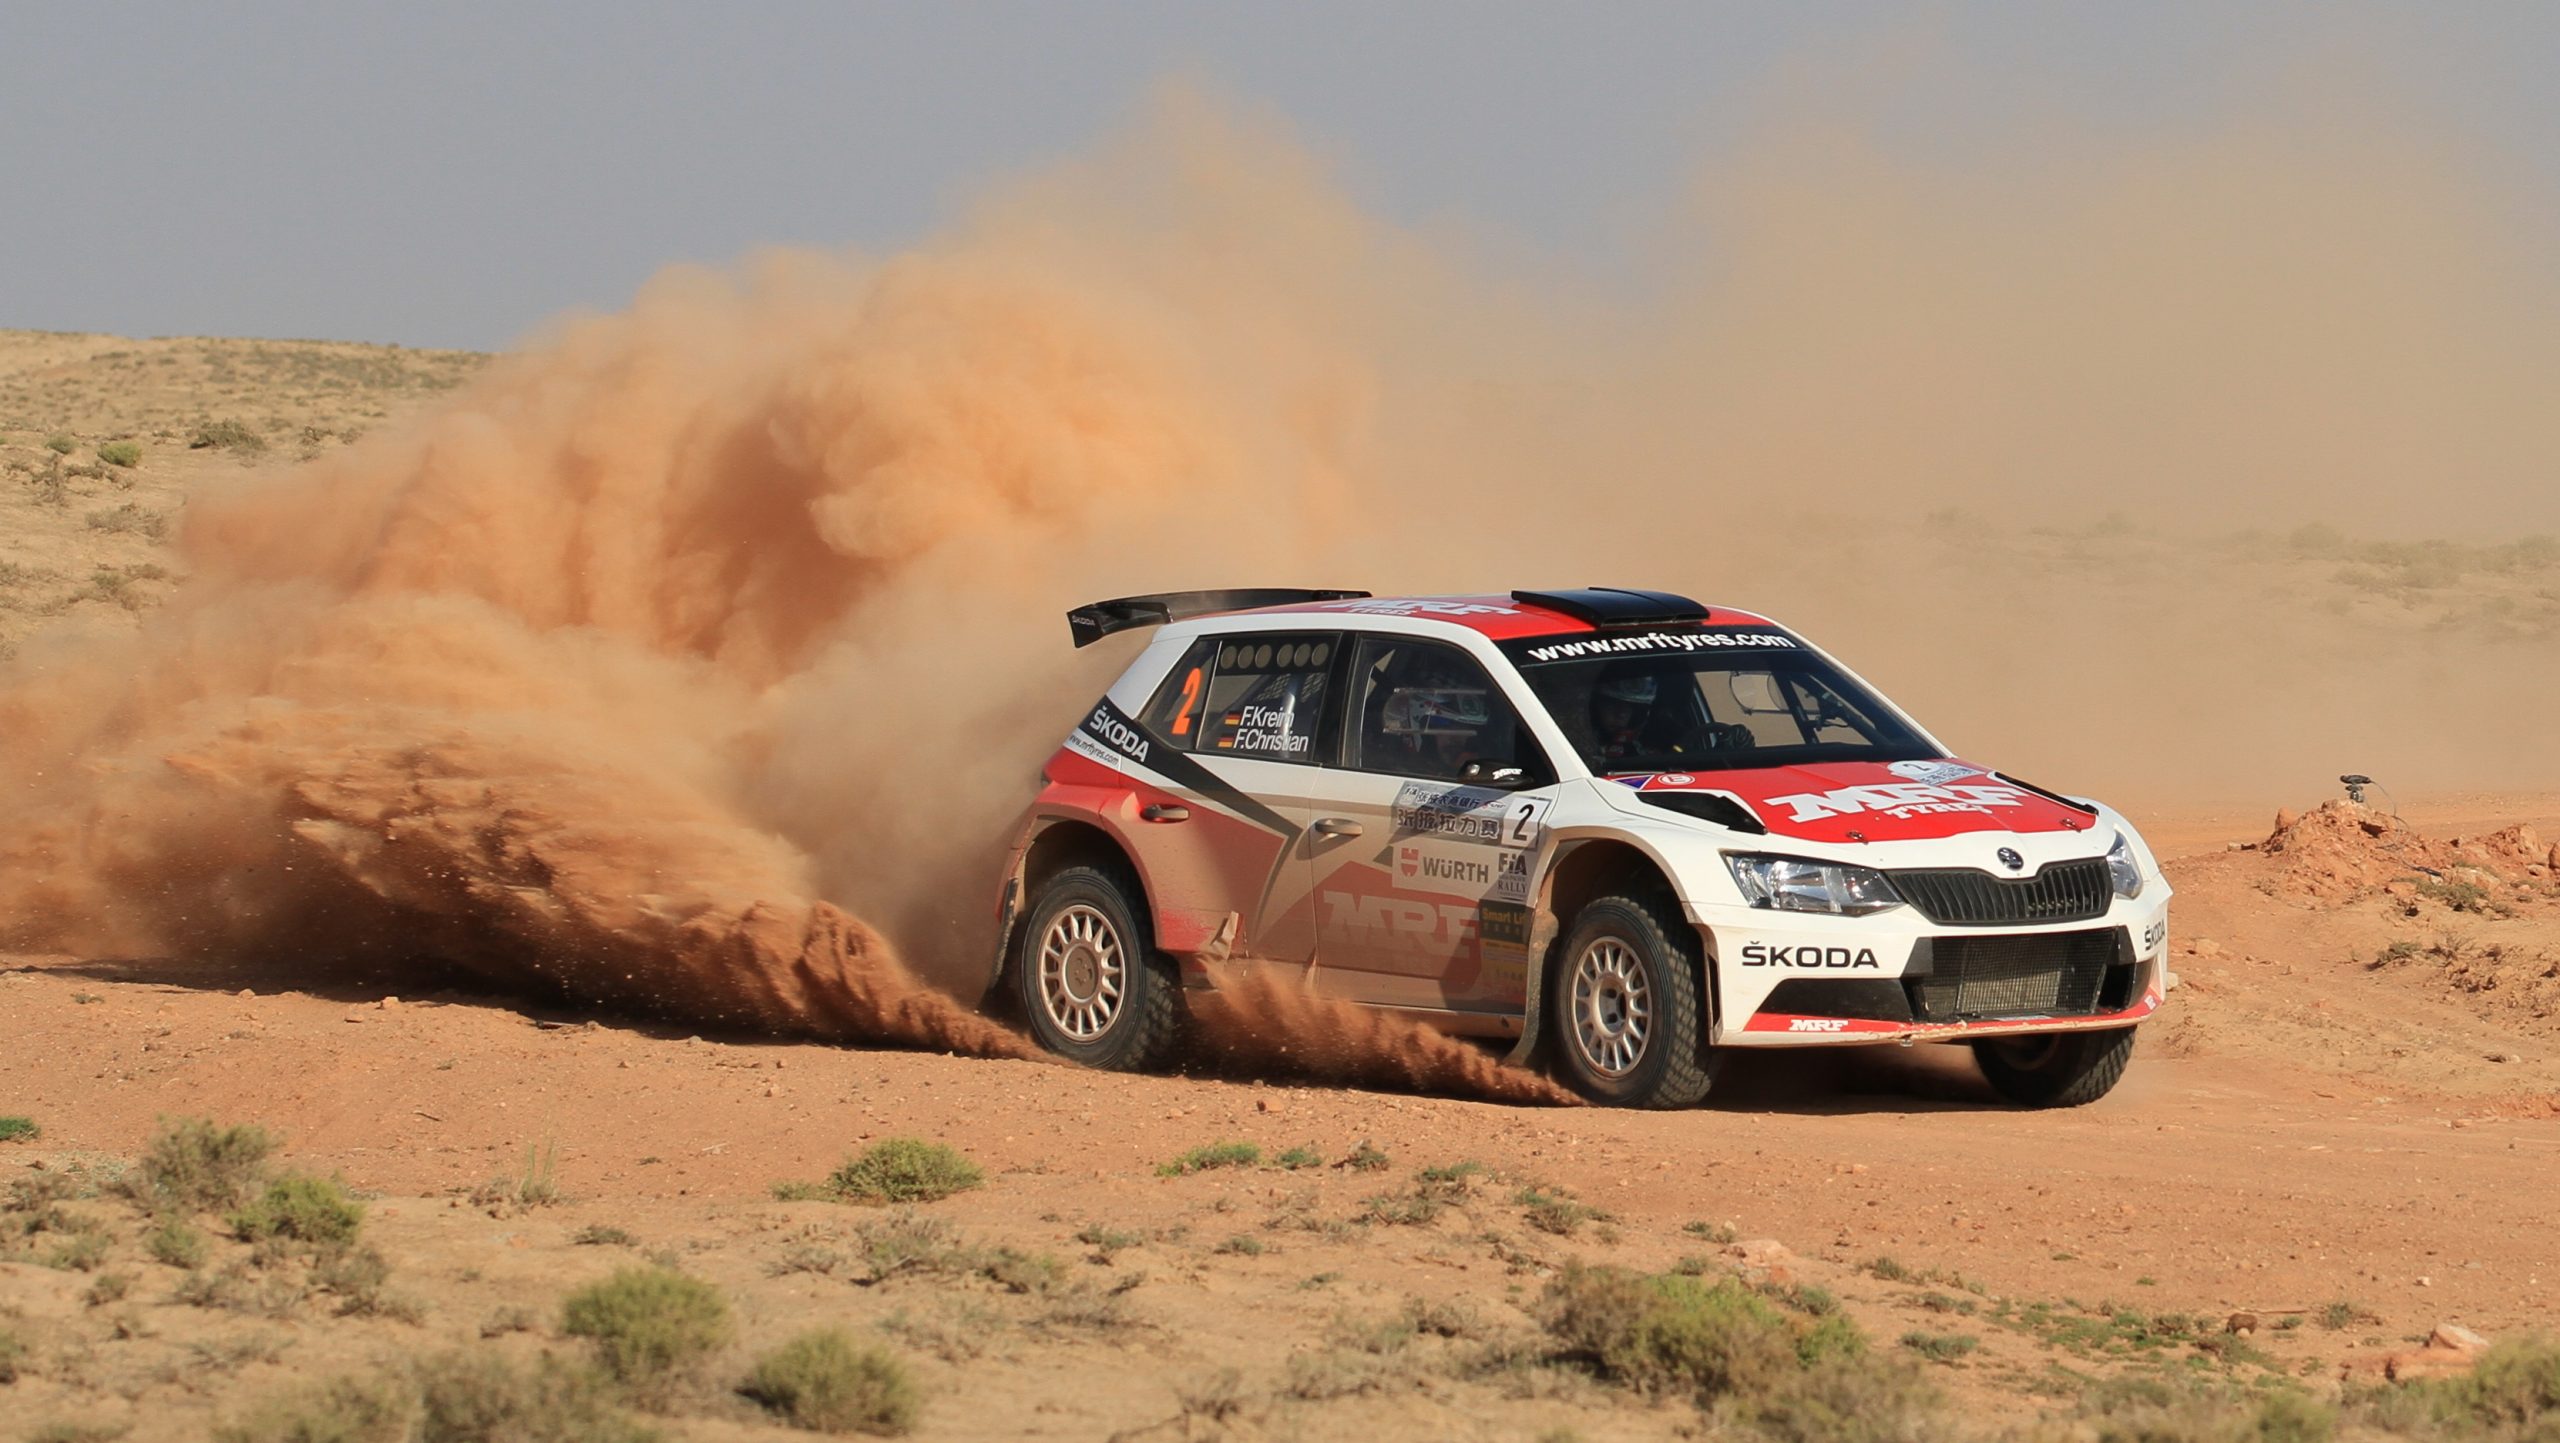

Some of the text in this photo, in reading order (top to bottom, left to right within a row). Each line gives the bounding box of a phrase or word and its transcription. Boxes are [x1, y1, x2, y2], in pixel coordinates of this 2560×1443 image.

[1528, 632, 1796, 661] www.mrftyres.com
[1172, 667, 1202, 735] 2
[1240, 705, 1294, 728] F.Kreim
[1089, 705, 1149, 762] ŠKODA
[1233, 728, 1309, 752] F.Christian
[1903, 763, 1930, 771] 2
[1763, 783, 2028, 823] MRF
[1884, 802, 1993, 819] TYRES
[1398, 808, 1499, 839] 张掖拉力赛
[1512, 804, 1534, 841] 2
[1423, 856, 1489, 884] WÜRTH
[1497, 881, 1527, 894] RALLY
[1323, 890, 1480, 960] MRF
[1742, 940, 1880, 969] ŠKODA
[1788, 1019, 1849, 1031] MRF
